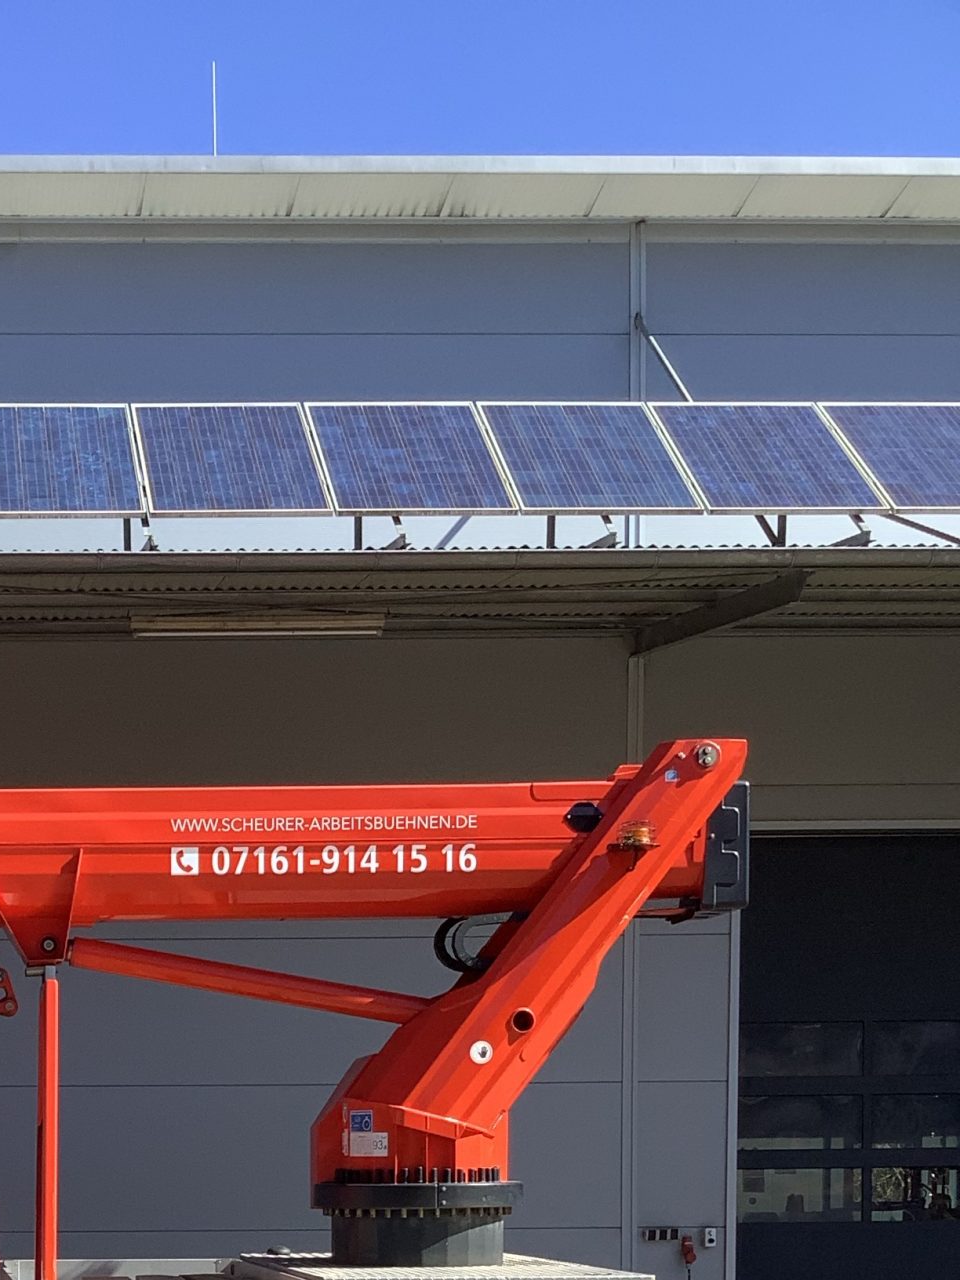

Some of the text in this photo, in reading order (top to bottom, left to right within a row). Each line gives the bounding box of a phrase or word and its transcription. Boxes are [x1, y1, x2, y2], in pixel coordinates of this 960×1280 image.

[171, 815, 478, 833] WWW.SCHEURER-ARBEITSBUEHNEN.DE
[211, 844, 478, 876] 07161-914 15 16
